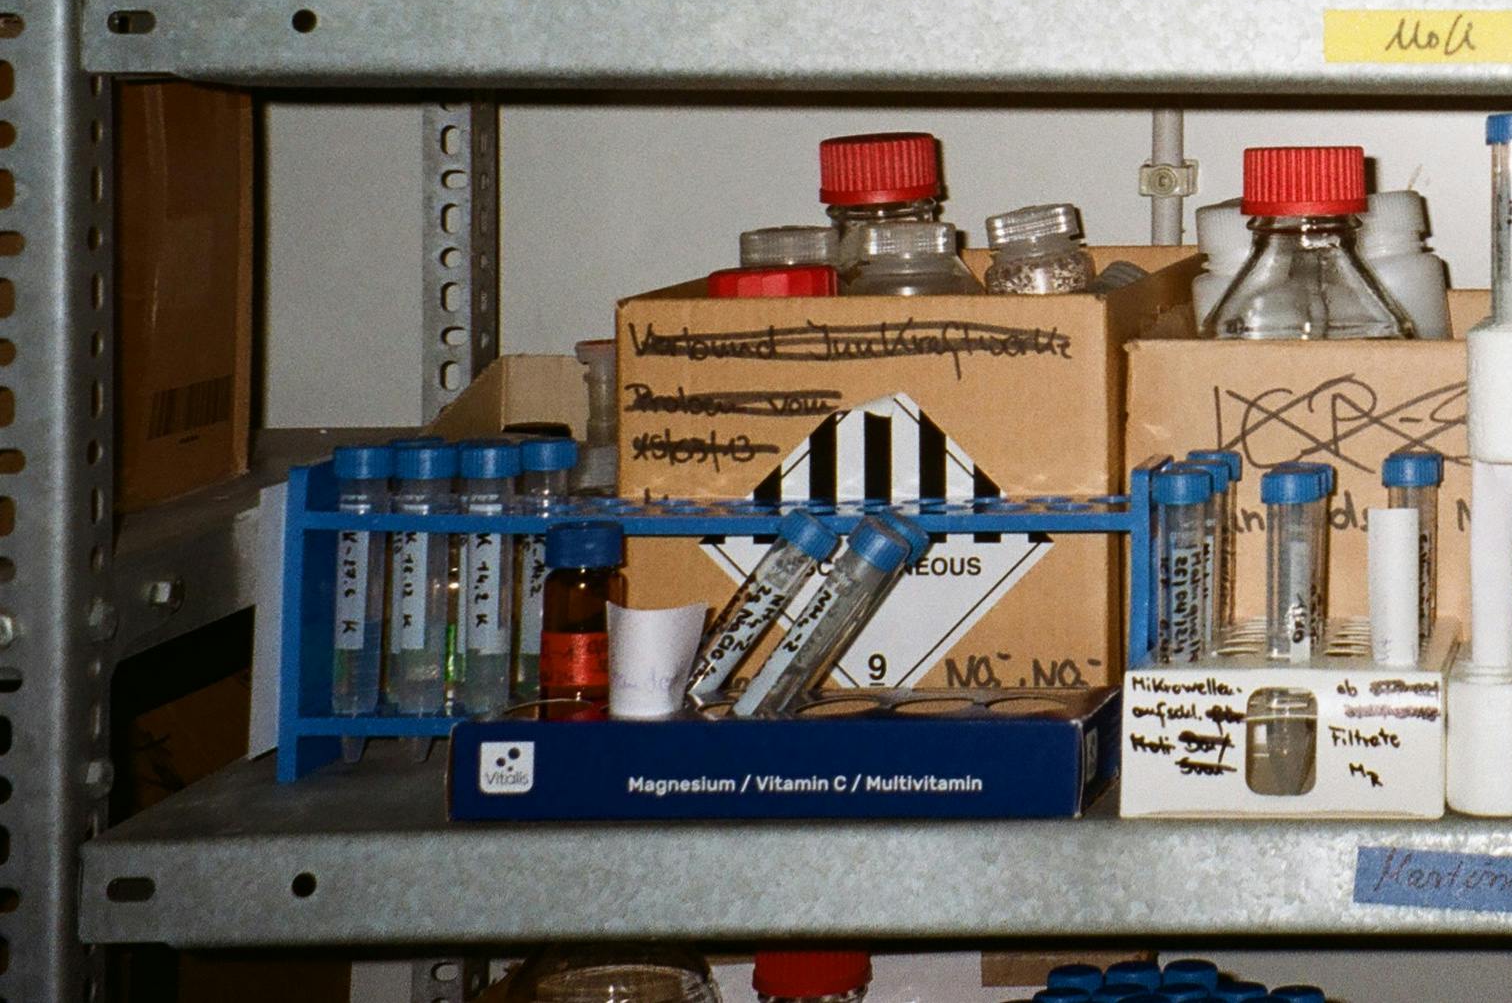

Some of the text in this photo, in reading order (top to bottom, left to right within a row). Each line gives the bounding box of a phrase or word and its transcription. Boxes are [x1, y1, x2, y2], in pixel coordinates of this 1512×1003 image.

[474, 532, 493, 629] K 14.2 K
[341, 619, 358, 634] K
[868, 654, 887, 679] 9
[485, 771, 529, 786] Vitalis
[628, 775, 736, 796] Magnesium
[756, 775, 830, 792] Vitamin
[833, 775, 848, 792] C
[866, 773, 984, 792] Multivitamin
